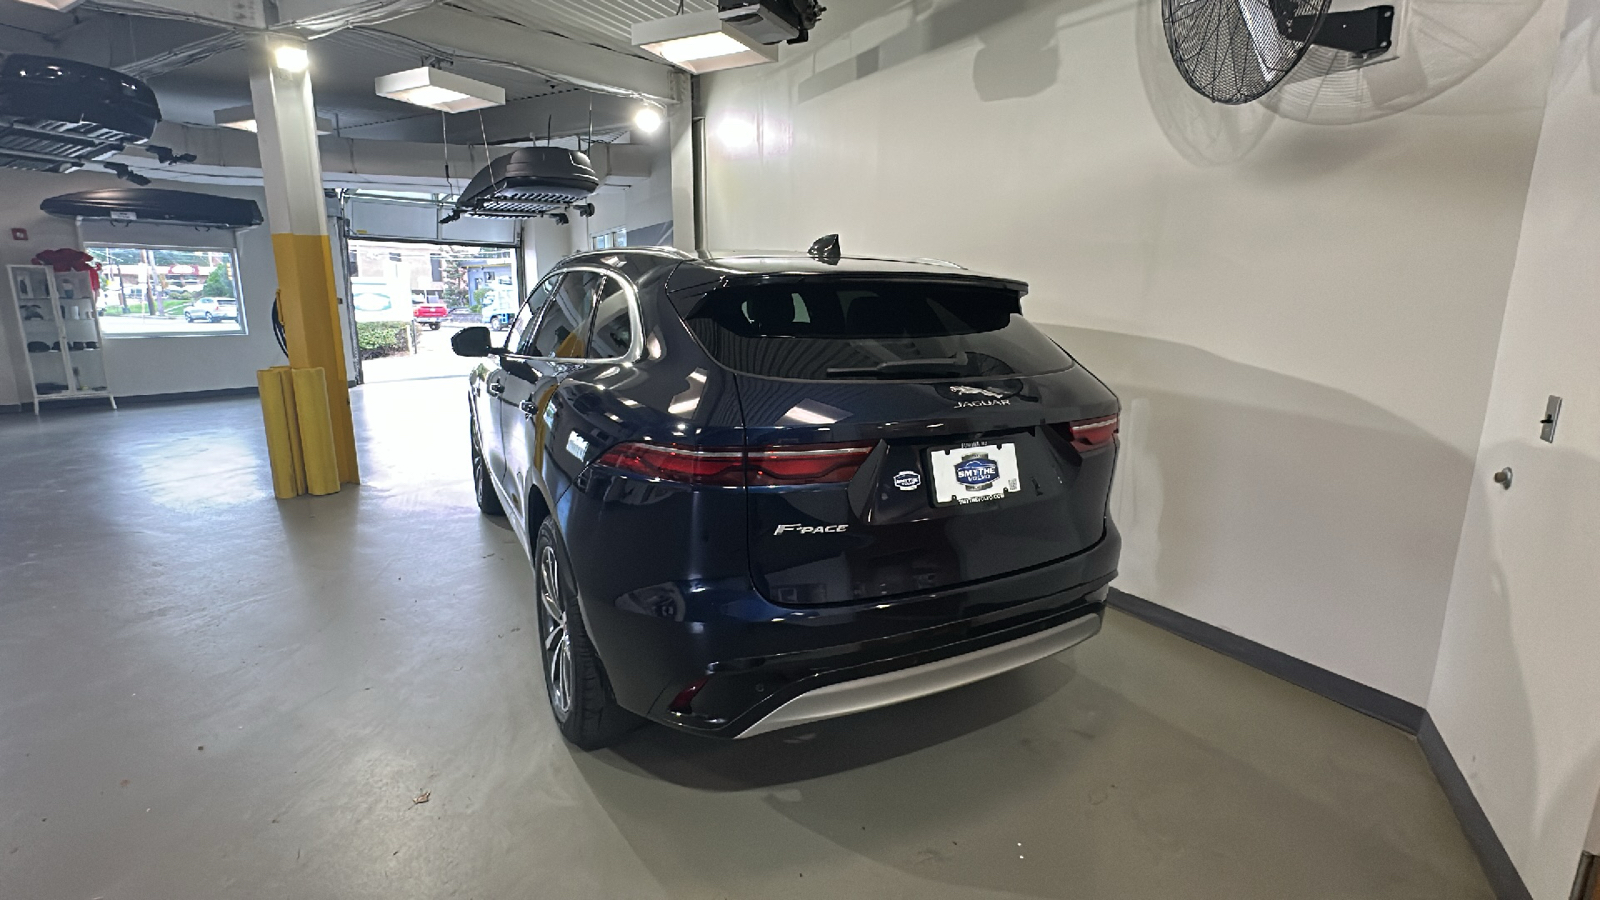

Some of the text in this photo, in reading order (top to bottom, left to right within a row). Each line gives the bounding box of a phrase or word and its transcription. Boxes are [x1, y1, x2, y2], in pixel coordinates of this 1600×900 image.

[953, 399, 1011, 409] JAGUAR
[957, 466, 996, 478] SMYTHE
[967, 474, 991, 482] VOLVO
